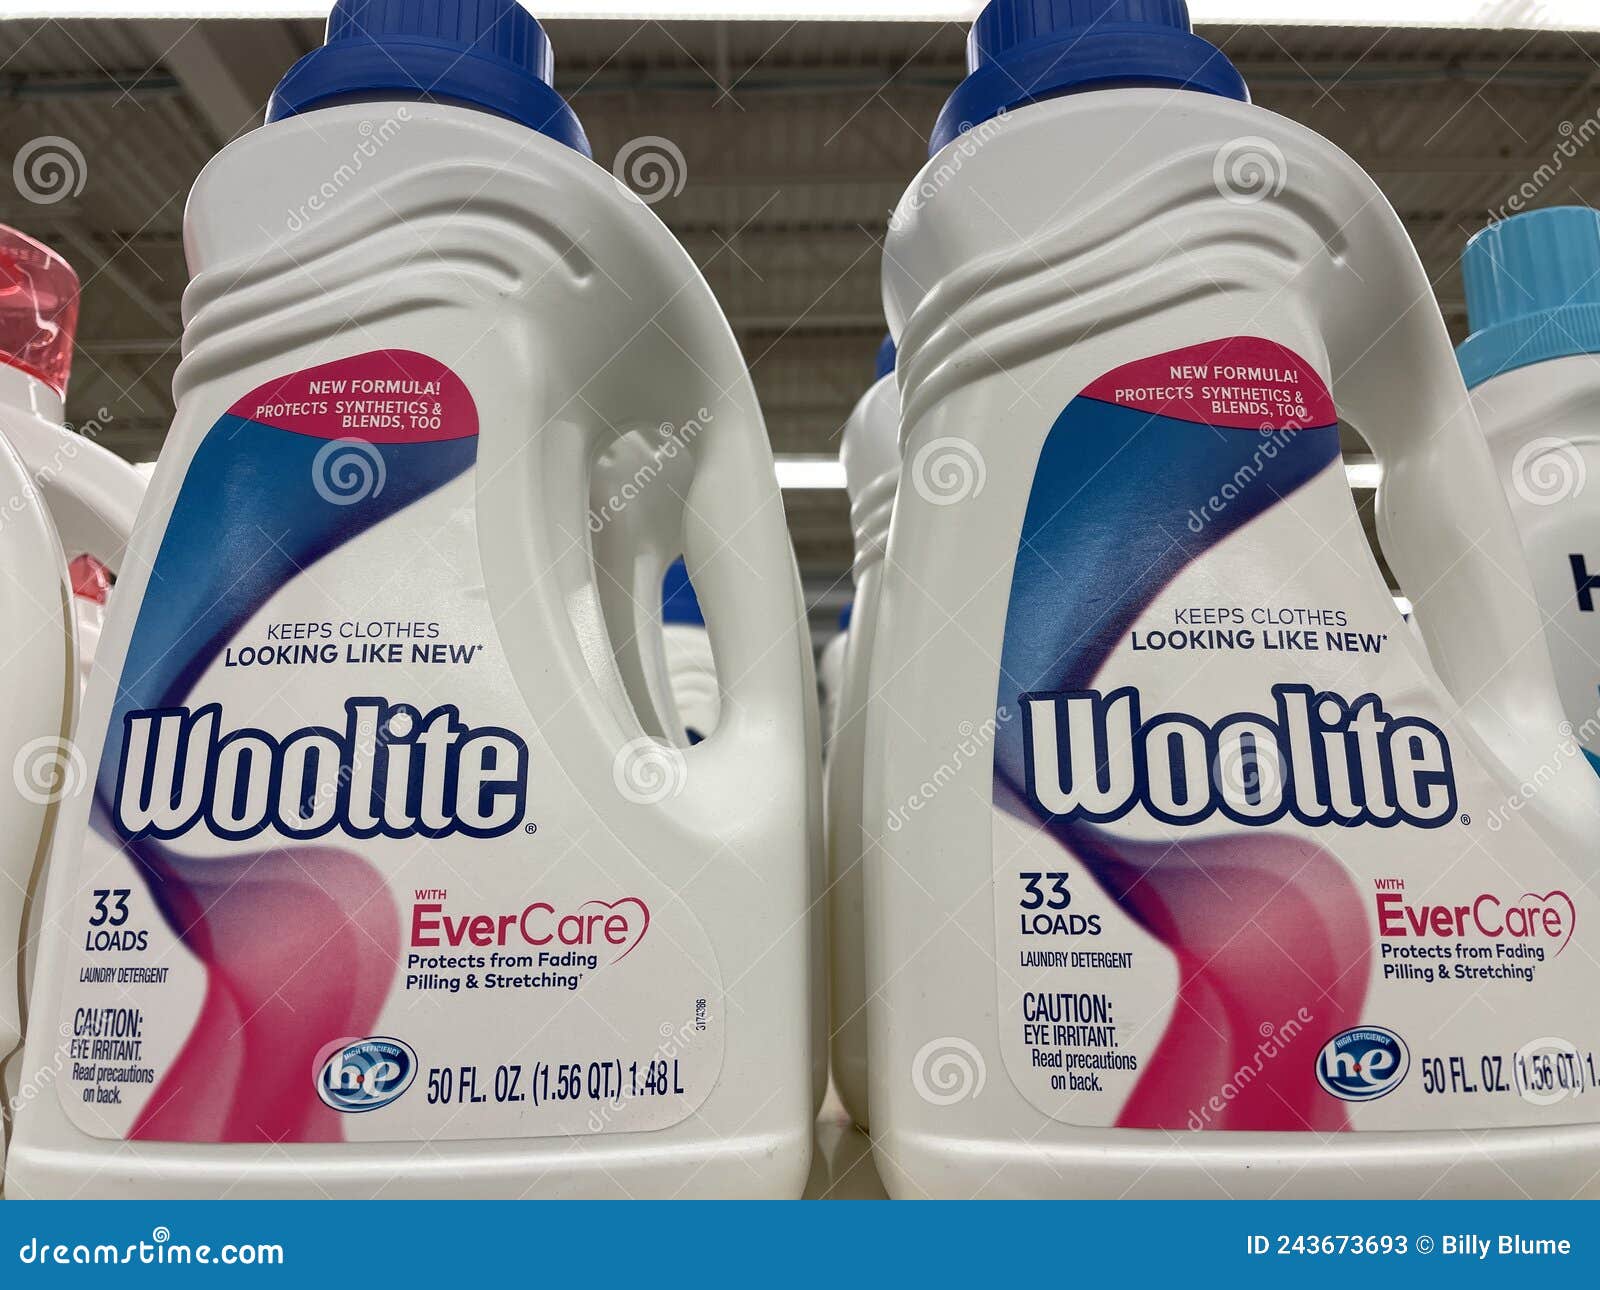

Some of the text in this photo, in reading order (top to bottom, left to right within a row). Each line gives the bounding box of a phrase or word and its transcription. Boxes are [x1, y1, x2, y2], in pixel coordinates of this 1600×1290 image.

[1170, 366, 1298, 383] NEW FORMULA!
[309, 380, 441, 395] NEW FORMULA!
[1115, 386, 1304, 403] PROTECTS SYNTHETICS &
[256, 400, 441, 418] PROTECTS SYNTHETICS &
[1212, 401, 1306, 417] BLENDS, TOO
[342, 414, 441, 430] BLENDS, TOO
[1175, 608, 1348, 627] KEEPS CLOTHES
[267, 622, 440, 640] KEEPS CLOTHES
[1131, 630, 1255, 651] LOOKING
[1263, 630, 1319, 650] LIKE
[225, 643, 338, 667] LOOKING
[346, 643, 403, 664] LIKE
[1019, 872, 1071, 909] 33
[1374, 878, 1405, 890] WITH
[414, 889, 447, 900] WITH
[89, 889, 131, 927] 33
[1375, 893, 1562, 937] EverCare
[410, 902, 629, 947] EverCare
[1021, 914, 1101, 935] LOADS
[85, 930, 148, 951] LOADS
[408, 951, 597, 970] Protects from Fading
[1020, 951, 1133, 968] LAUNDRY DETERGENT
[1381, 943, 1545, 961] Protects from Fading
[80, 967, 169, 984] LAUNDRY DETERGENT
[1383, 964, 1434, 982] Pilling
[1438, 964, 1450, 979] &
[406, 974, 460, 992] Pilling
[465, 974, 479, 989] &
[1023, 992, 1113, 1023] CAUTION:
[73, 1007, 143, 1037] CAUTION:
[1024, 1024, 1118, 1048] EYE IRRITANT.
[1336, 1033, 1391, 1048] HIGH EFFICIENCY
[70, 1039, 142, 1061] EYE IRRITANT.
[1032, 1048, 1137, 1071] Read precautions
[72, 1062, 154, 1084] Read precautions
[428, 1058, 684, 1106] 50 FL. OZ. (1.56 QT.) 1.48 L
[1051, 1072, 1103, 1092] on back.
[1422, 1057, 1446, 1094] 50
[1450, 1057, 1477, 1093] FL.
[1482, 1055, 1509, 1092] OZ.
[1513, 1052, 1553, 1096] (1.56
[1557, 1050, 1585, 1093] QT.)
[83, 1085, 122, 1104] on back.
